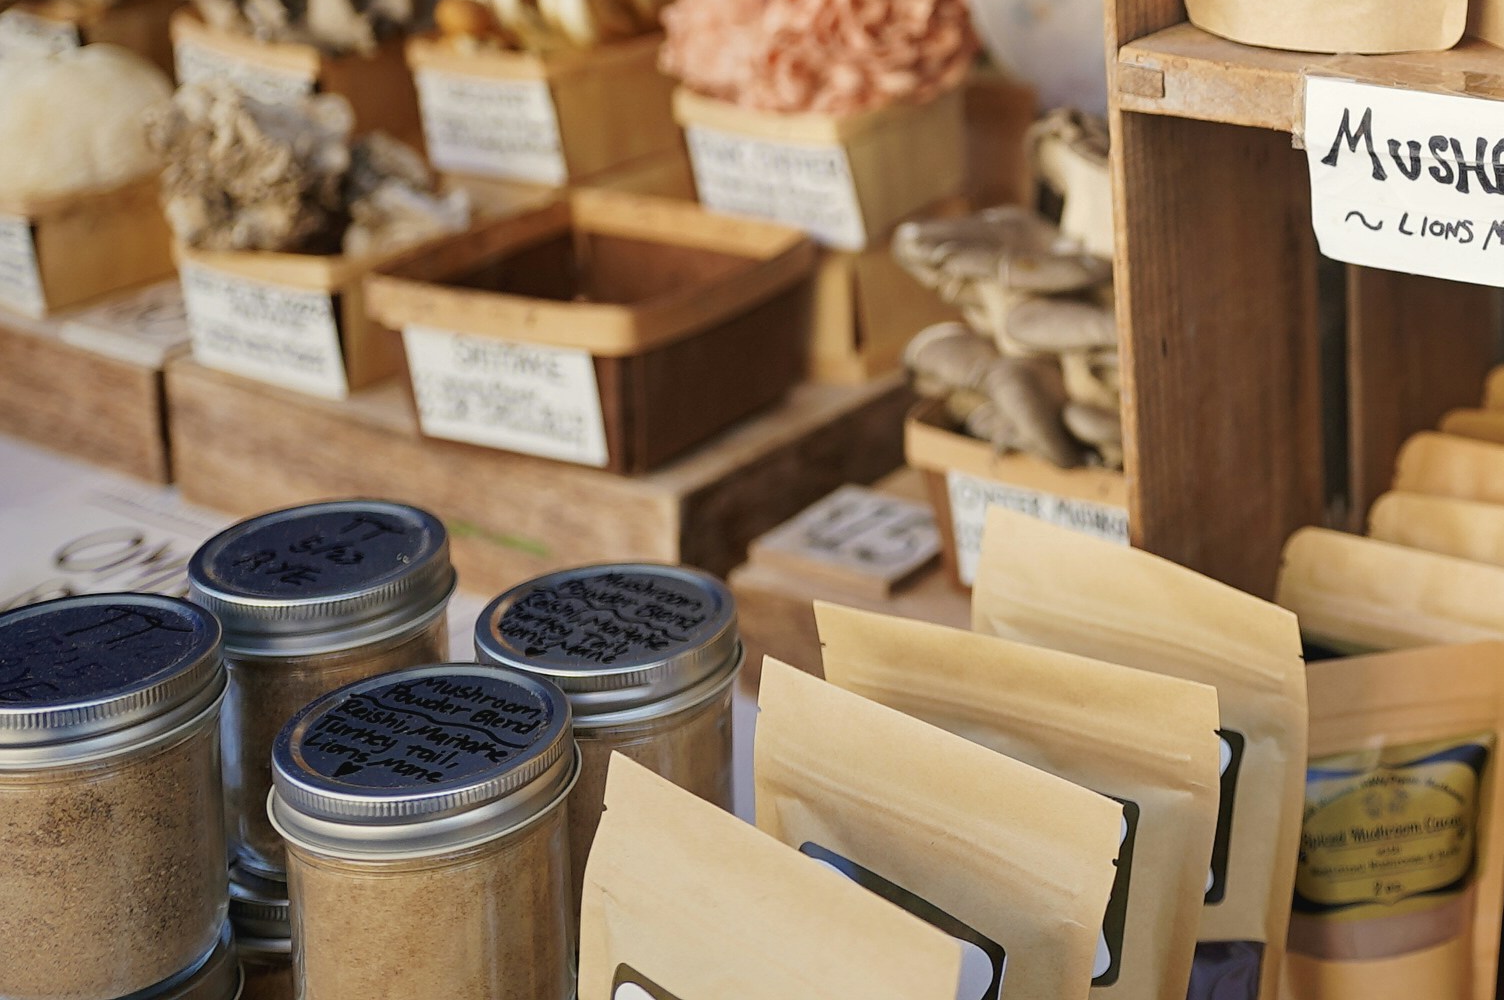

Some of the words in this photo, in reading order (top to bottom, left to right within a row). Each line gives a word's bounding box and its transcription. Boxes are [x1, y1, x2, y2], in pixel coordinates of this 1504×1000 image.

[1399, 212, 1474, 243] LIONS
[382, 683, 472, 714] Powder
[470, 709, 542, 735] Blend
[415, 677, 542, 719] Mushroom
[303, 732, 369, 763] Lions
[314, 714, 399, 752] Turkey
